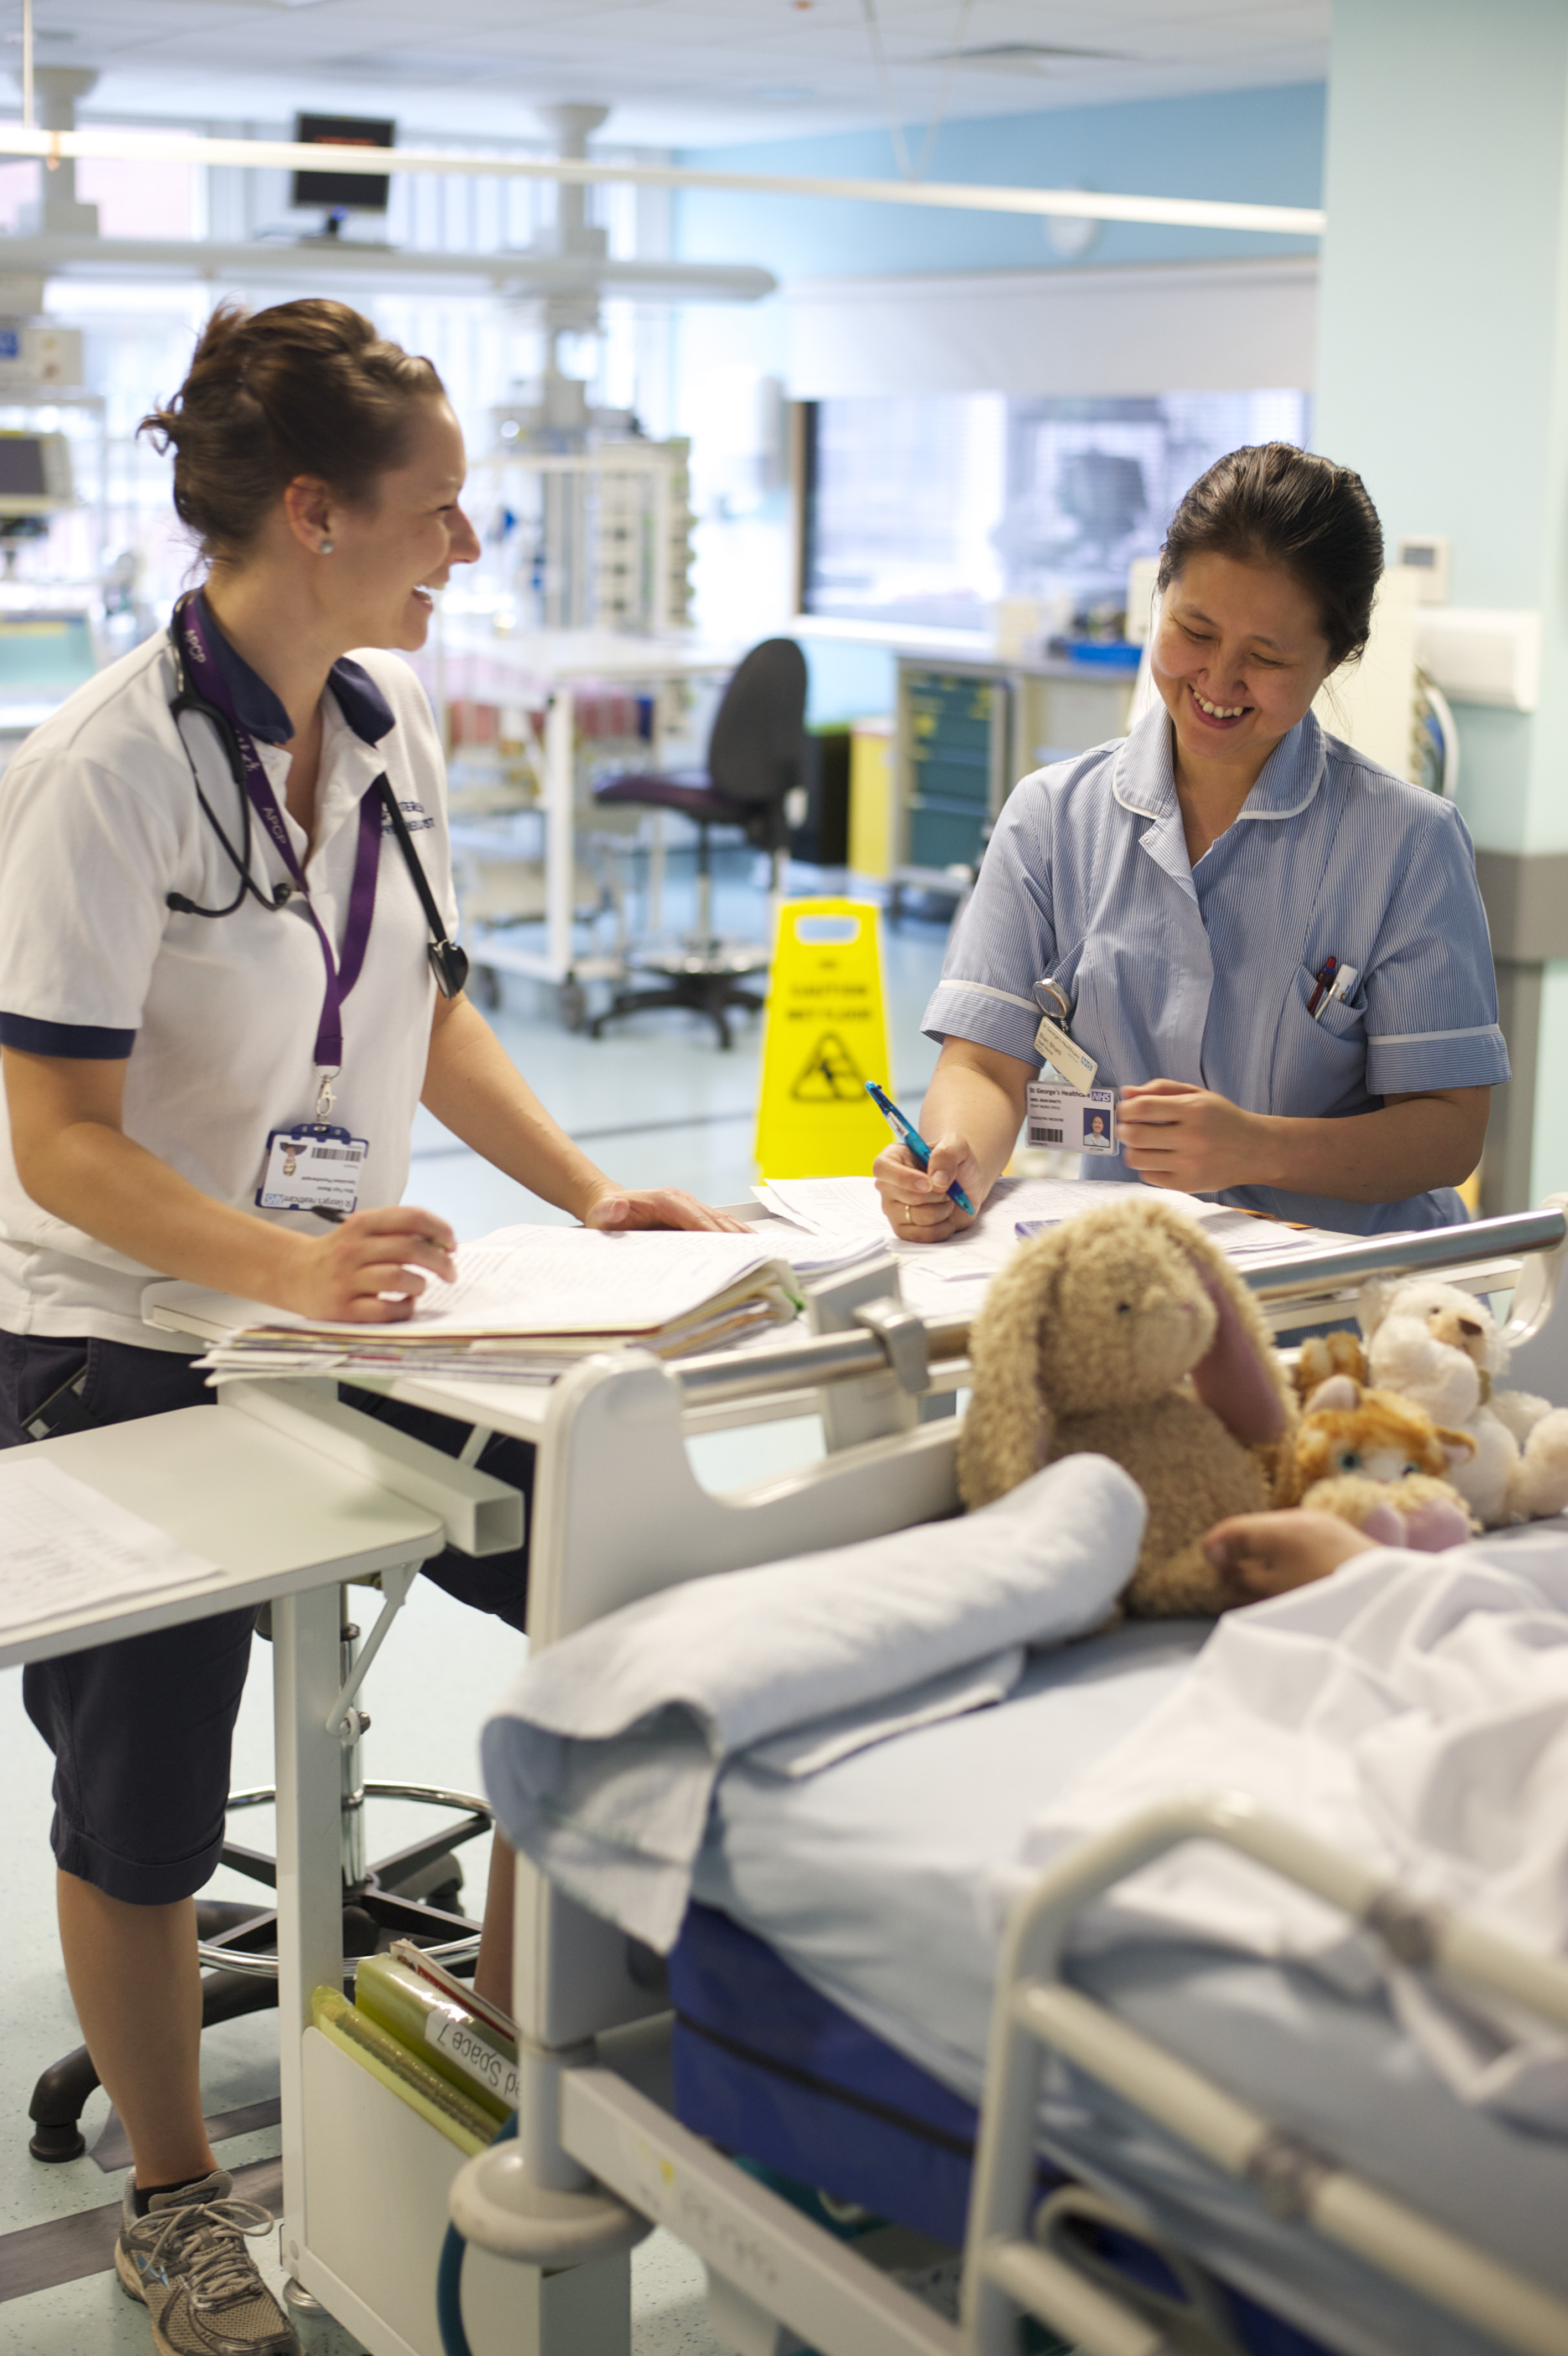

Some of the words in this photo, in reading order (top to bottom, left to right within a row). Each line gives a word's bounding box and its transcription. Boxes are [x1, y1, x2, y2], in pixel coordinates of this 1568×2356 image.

[183, 629, 207, 664] APCP
[262, 807, 288, 846] APCP
[1081, 1056, 1094, 1071] NHS
[1036, 1088, 1060, 1096] George's
[1092, 1092, 1111, 1102] NHS
[437, 2023, 450, 2047] 7
[452, 2032, 502, 2087] Space
